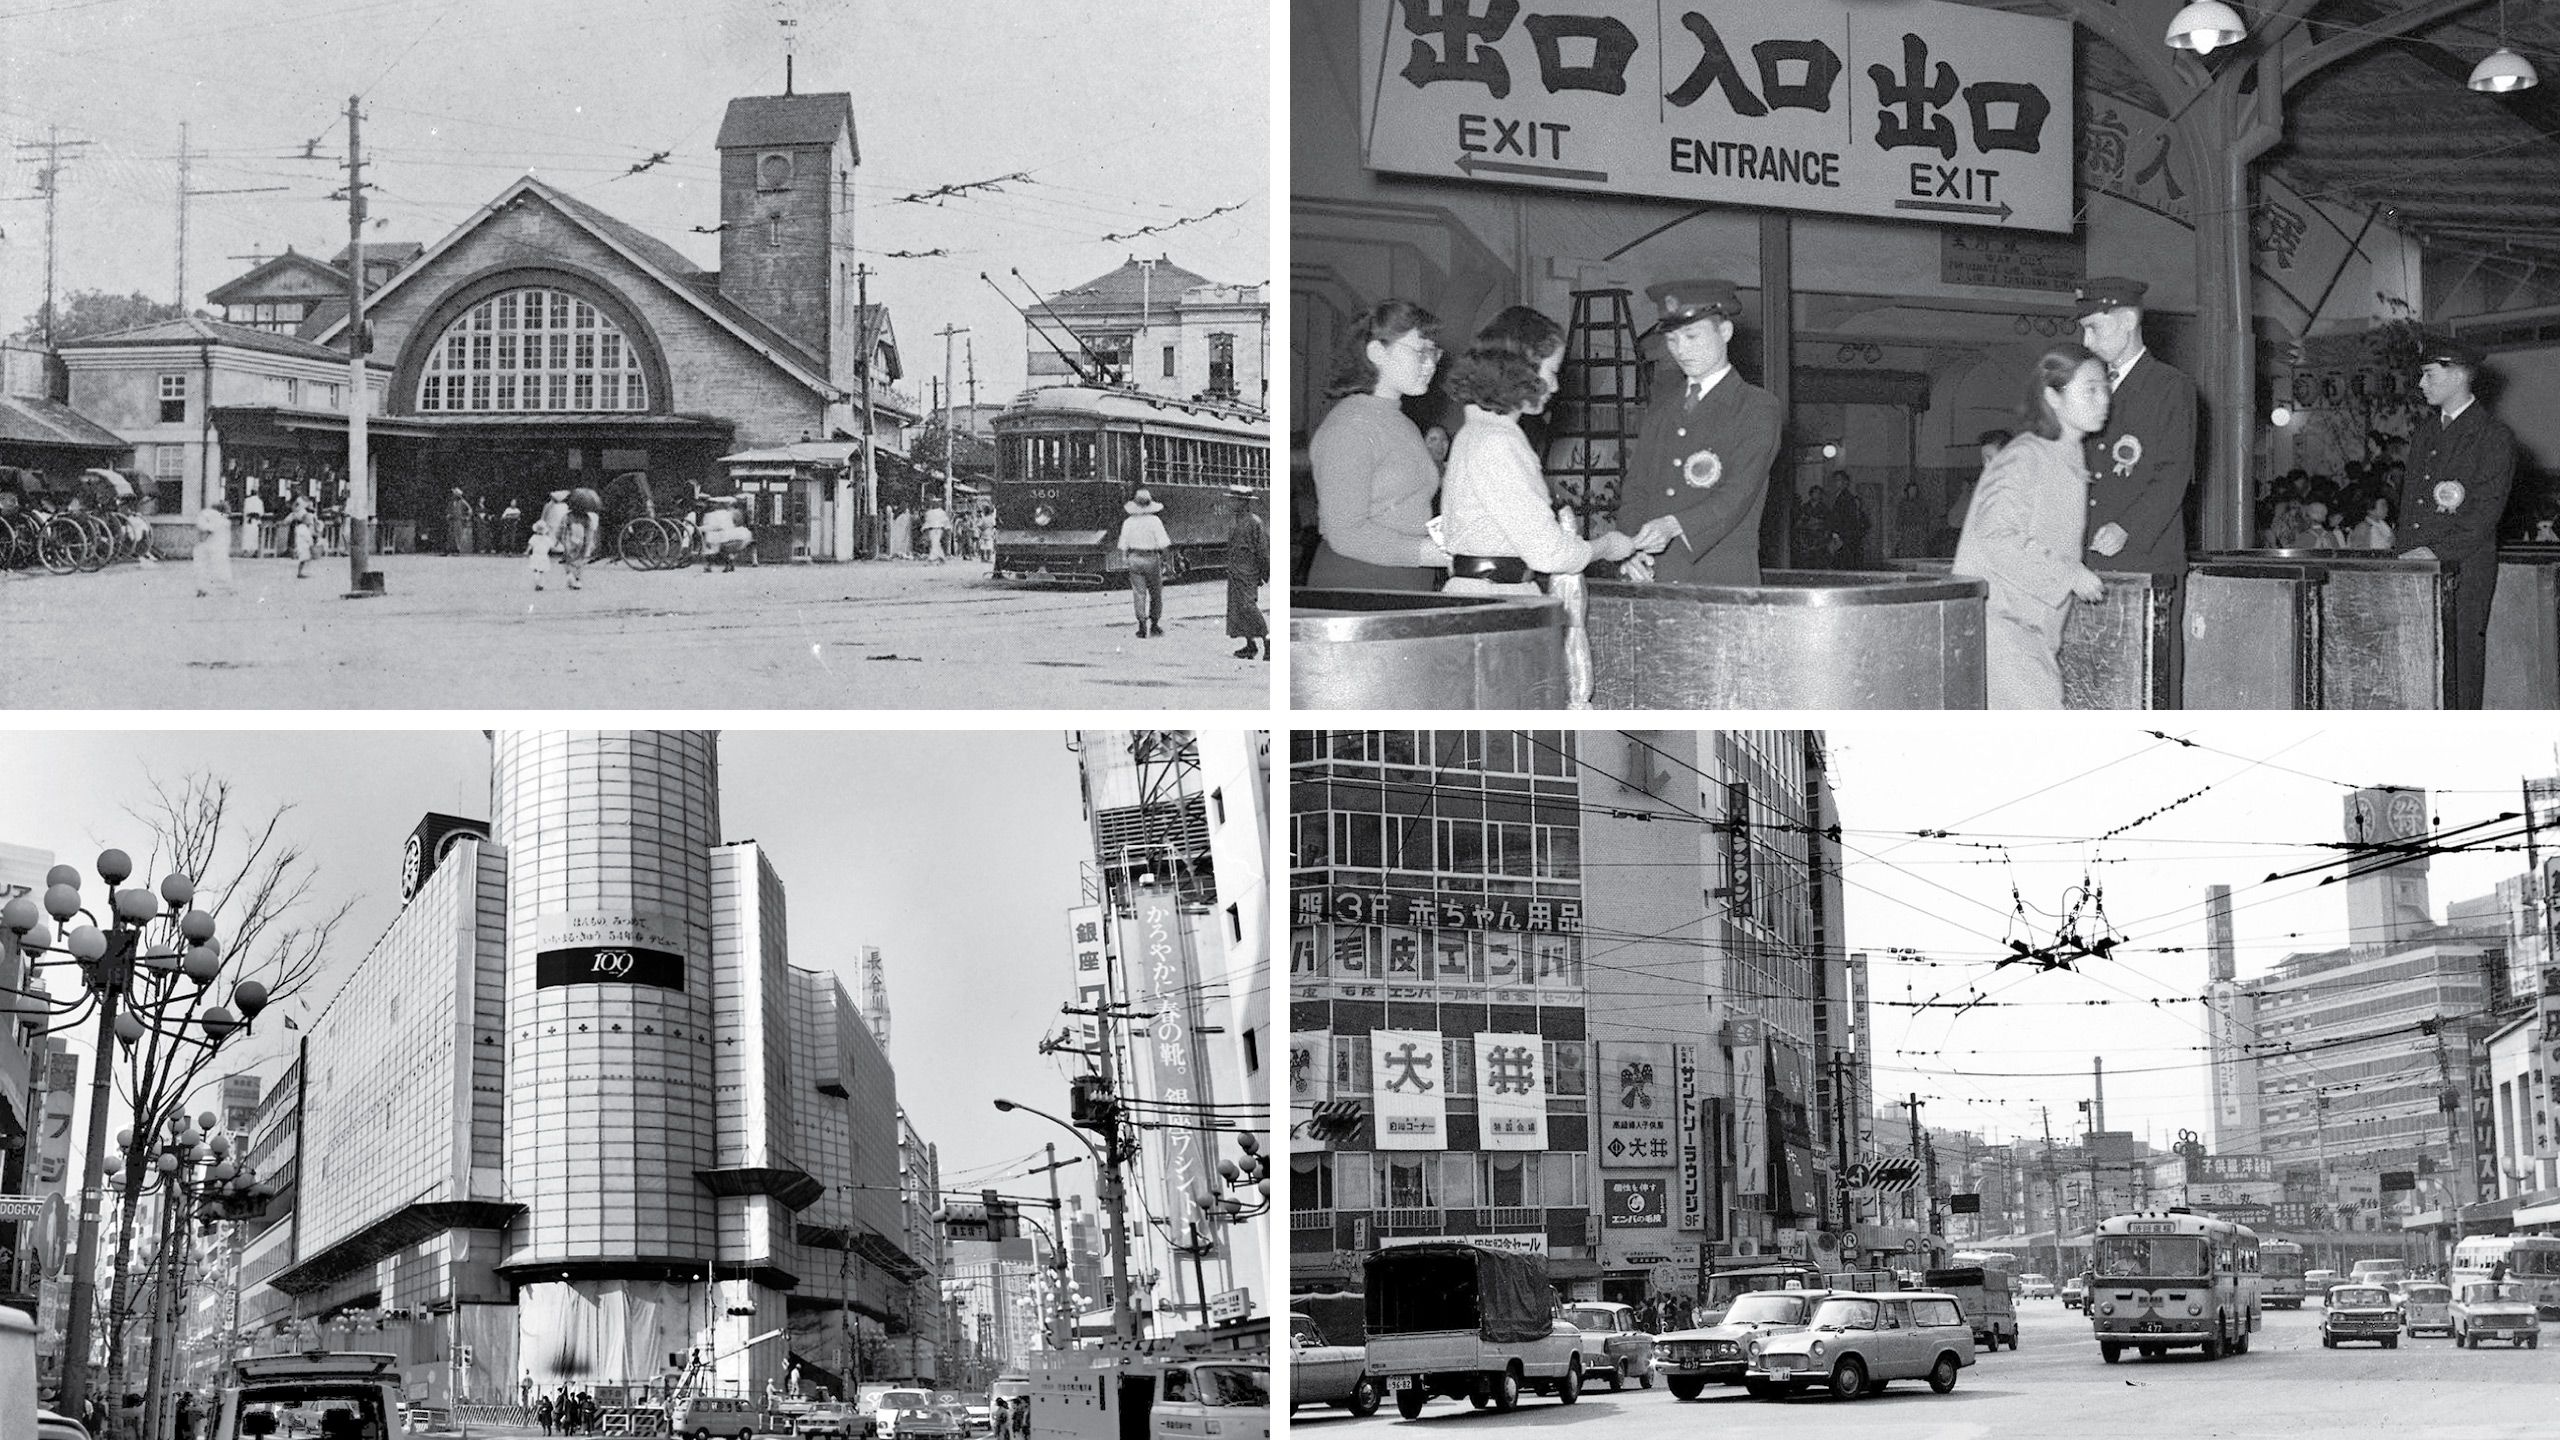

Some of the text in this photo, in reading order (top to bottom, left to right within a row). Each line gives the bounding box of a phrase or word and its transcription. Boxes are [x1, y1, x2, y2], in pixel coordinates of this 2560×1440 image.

[1400, 0, 1639, 99] 出口
[1665, 11, 1842, 117] 入口
[1867, 32, 2051, 161] 出口
[1458, 114, 1571, 160] EXIT
[1671, 137, 1839, 188] ENTRANCE
[1910, 163, 2000, 202] EXIT
[1408, 896, 1583, 931] 赤ちゃん用品
[590, 952, 634, 978] 109
[1146, 905, 1188, 1077] かろやかに春の靴。
[1383, 1042, 1434, 1094] 大
[1487, 1044, 1535, 1096] 井
[1628, 1137, 1668, 1158] 大井
[1685, 1214, 1700, 1227] 9F
